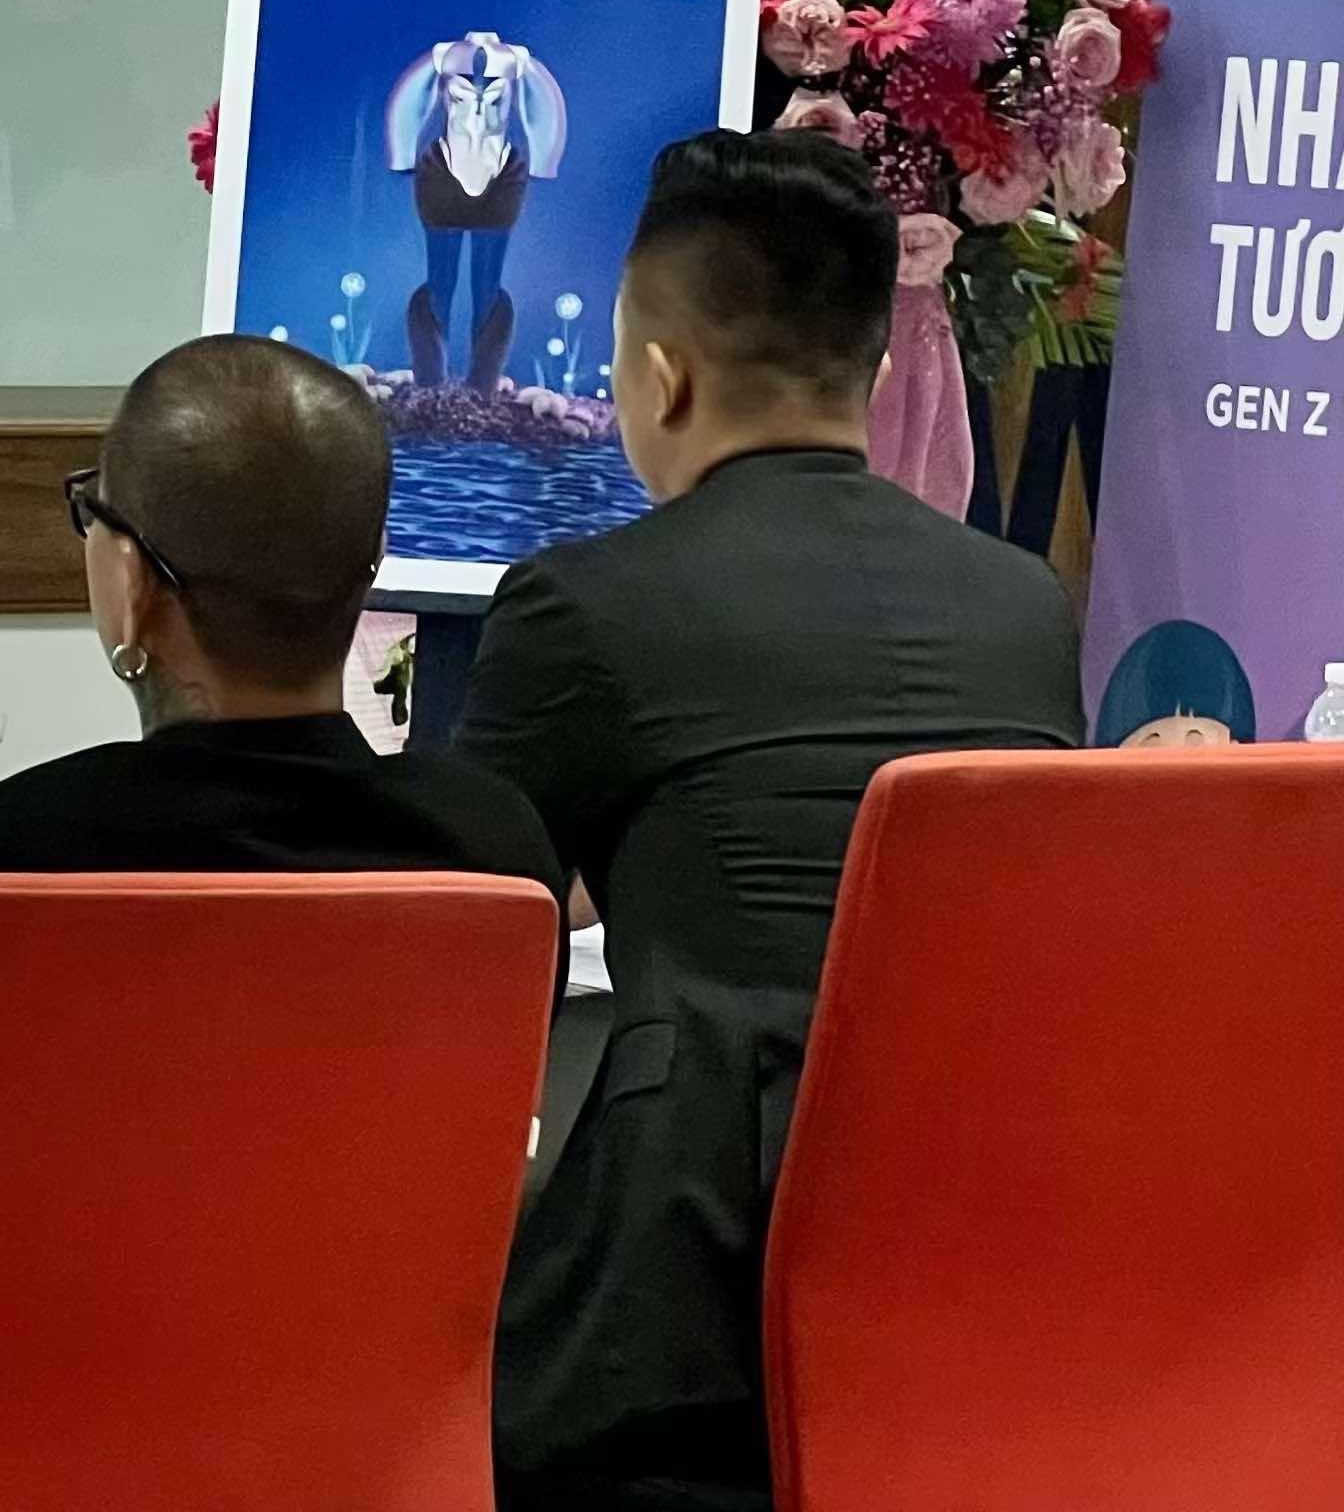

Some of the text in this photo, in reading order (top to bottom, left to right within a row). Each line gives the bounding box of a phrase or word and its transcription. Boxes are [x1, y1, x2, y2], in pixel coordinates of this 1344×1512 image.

[1216, 56, 1344, 189] NH
[1206, 383, 1331, 436] GEN Z
